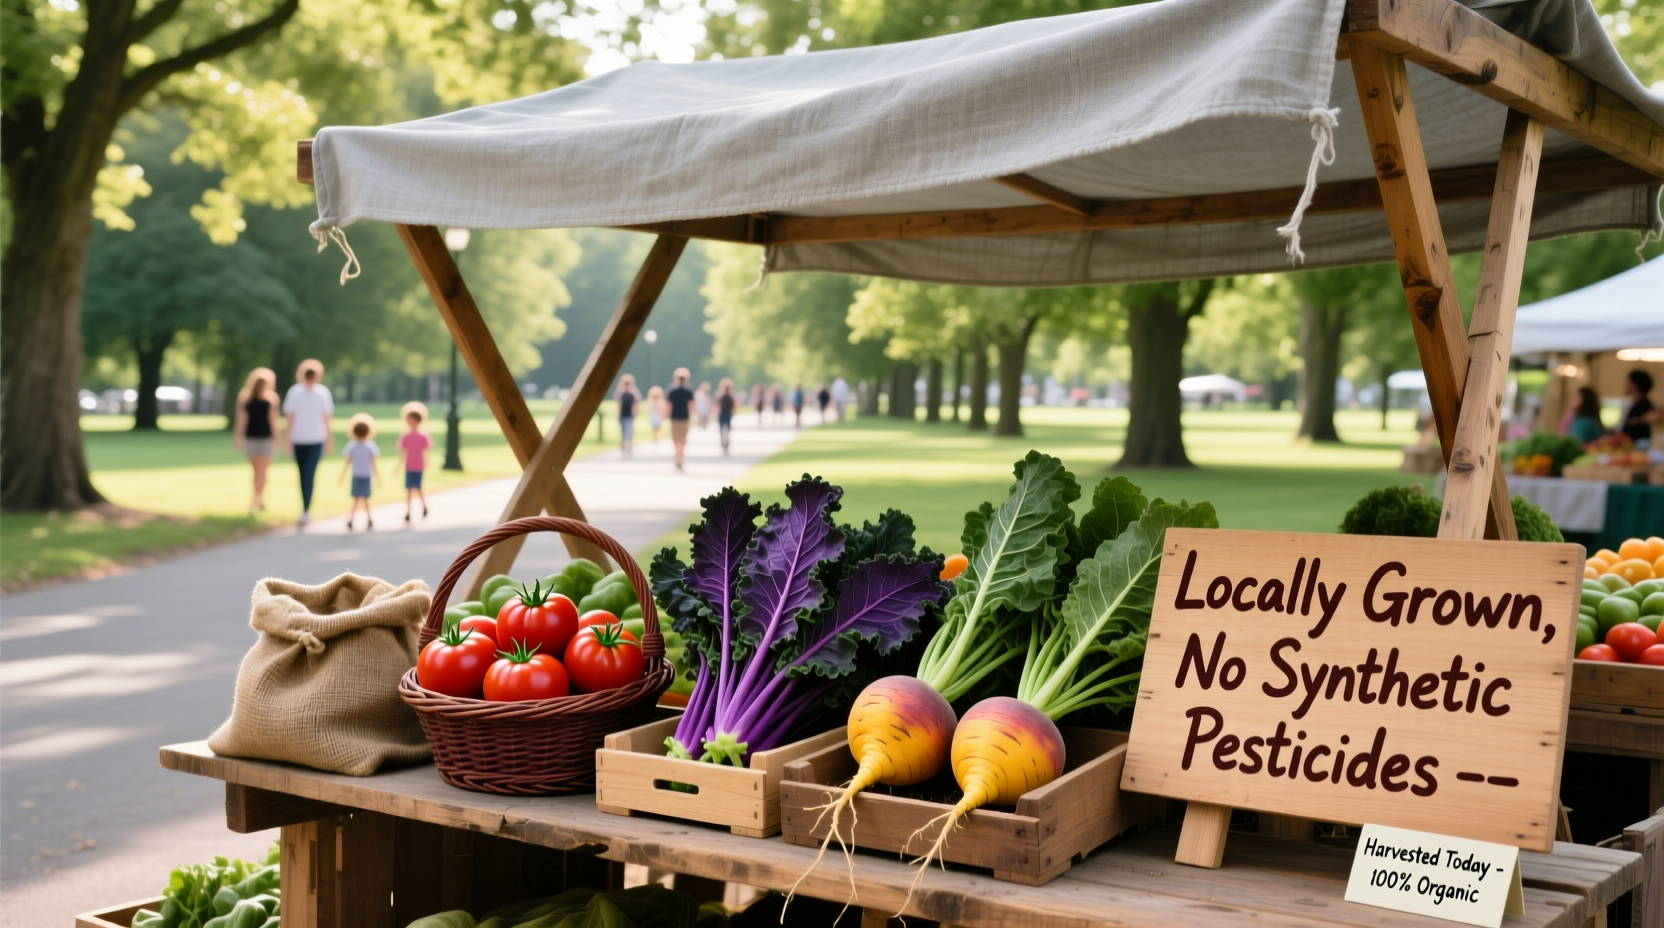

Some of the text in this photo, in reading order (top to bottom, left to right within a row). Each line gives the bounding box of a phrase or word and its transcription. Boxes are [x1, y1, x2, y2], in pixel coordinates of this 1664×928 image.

[1174, 549, 1557, 645] Locally Grown,
[1174, 631, 1513, 720] No Synthetic
[1181, 706, 1440, 797] Pesticides
[1363, 837, 1442, 866] Harvested
[1446, 849, 1491, 882] Today
[1370, 868, 1480, 906] 100% Organic
